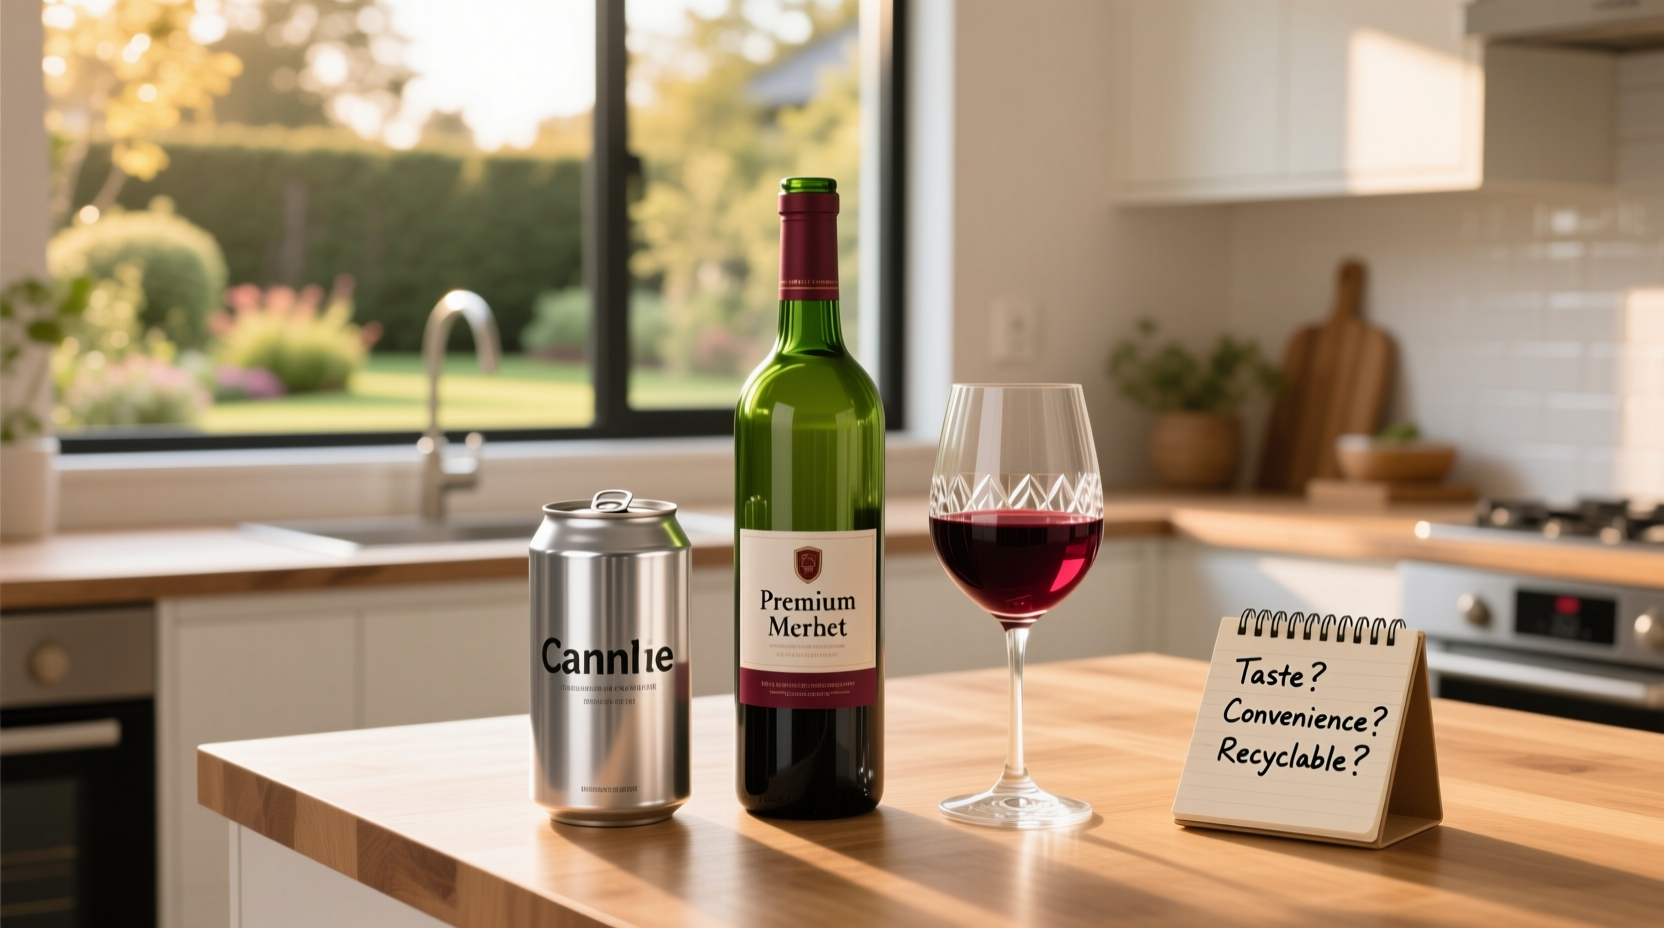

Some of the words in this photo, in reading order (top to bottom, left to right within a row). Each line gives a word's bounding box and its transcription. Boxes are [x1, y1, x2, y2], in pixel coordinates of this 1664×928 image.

[760, 589, 856, 611] Premium
[1236, 657, 1327, 692] Taste?
[1223, 697, 1389, 737] Convenience?
[1217, 736, 1370, 777] Recyclable?
